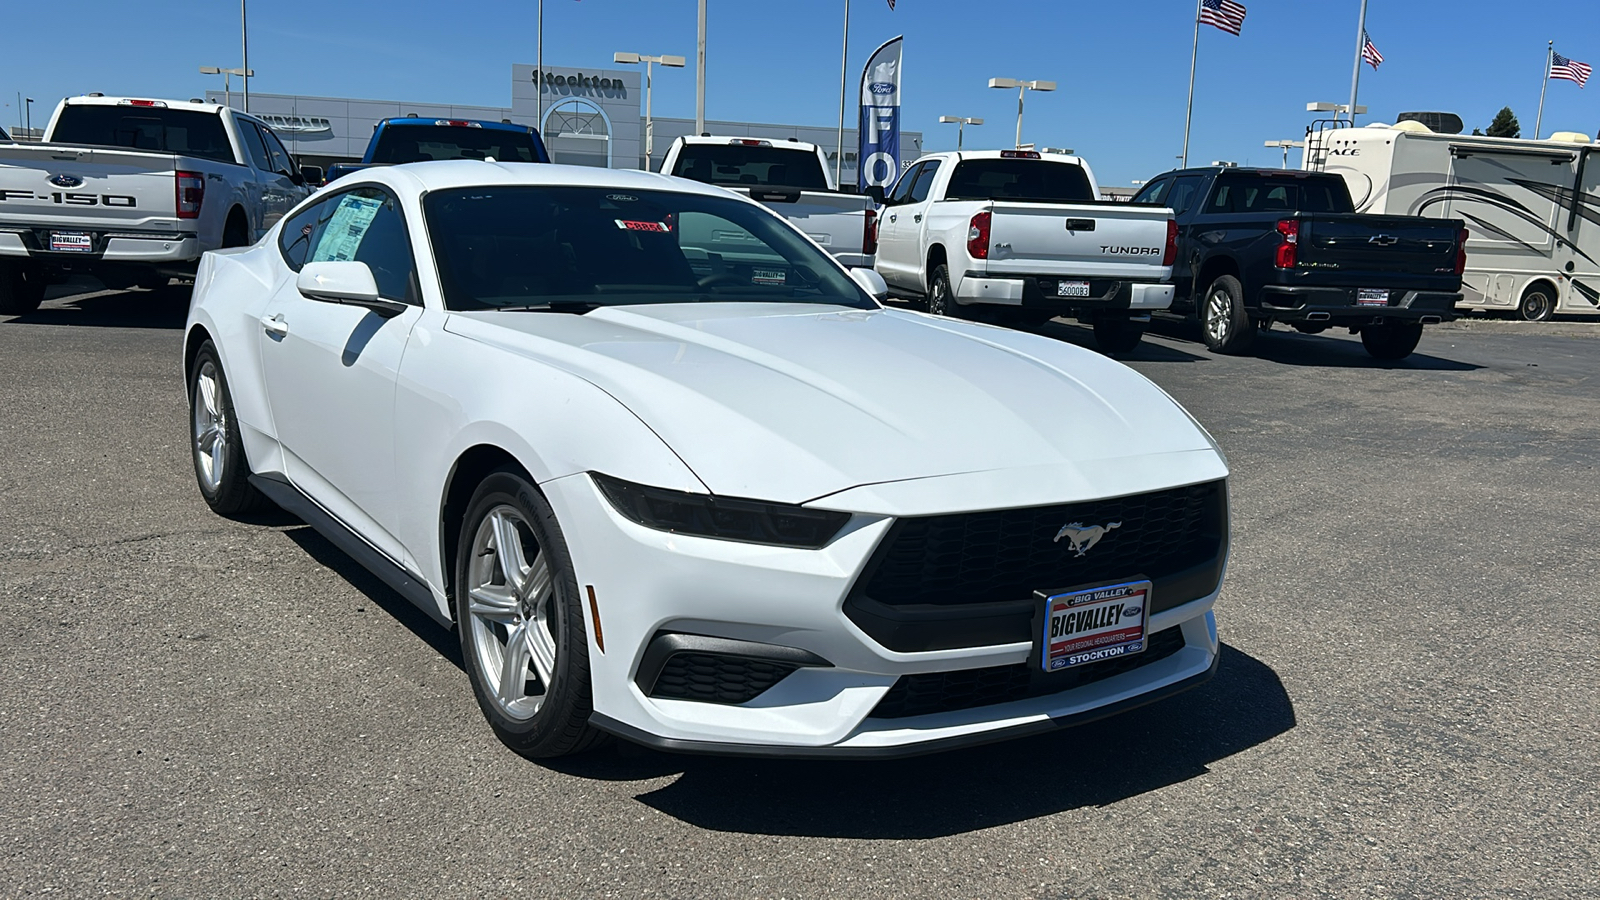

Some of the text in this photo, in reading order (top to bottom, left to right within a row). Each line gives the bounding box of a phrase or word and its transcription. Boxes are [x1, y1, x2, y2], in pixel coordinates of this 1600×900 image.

[532, 69, 624, 90] Stockton
[873, 83, 892, 93] Ford
[0, 190, 137, 207] F-150
[1100, 245, 1160, 256] TUNDRA
[1074, 587, 1128, 604] BIG VALLEY
[1051, 603, 1125, 638] BIGVALLEY
[1064, 644, 1075, 652] YOUR
[1094, 632, 1126, 645] HEADQUARTERS
[1069, 646, 1125, 664] STOCKTON
